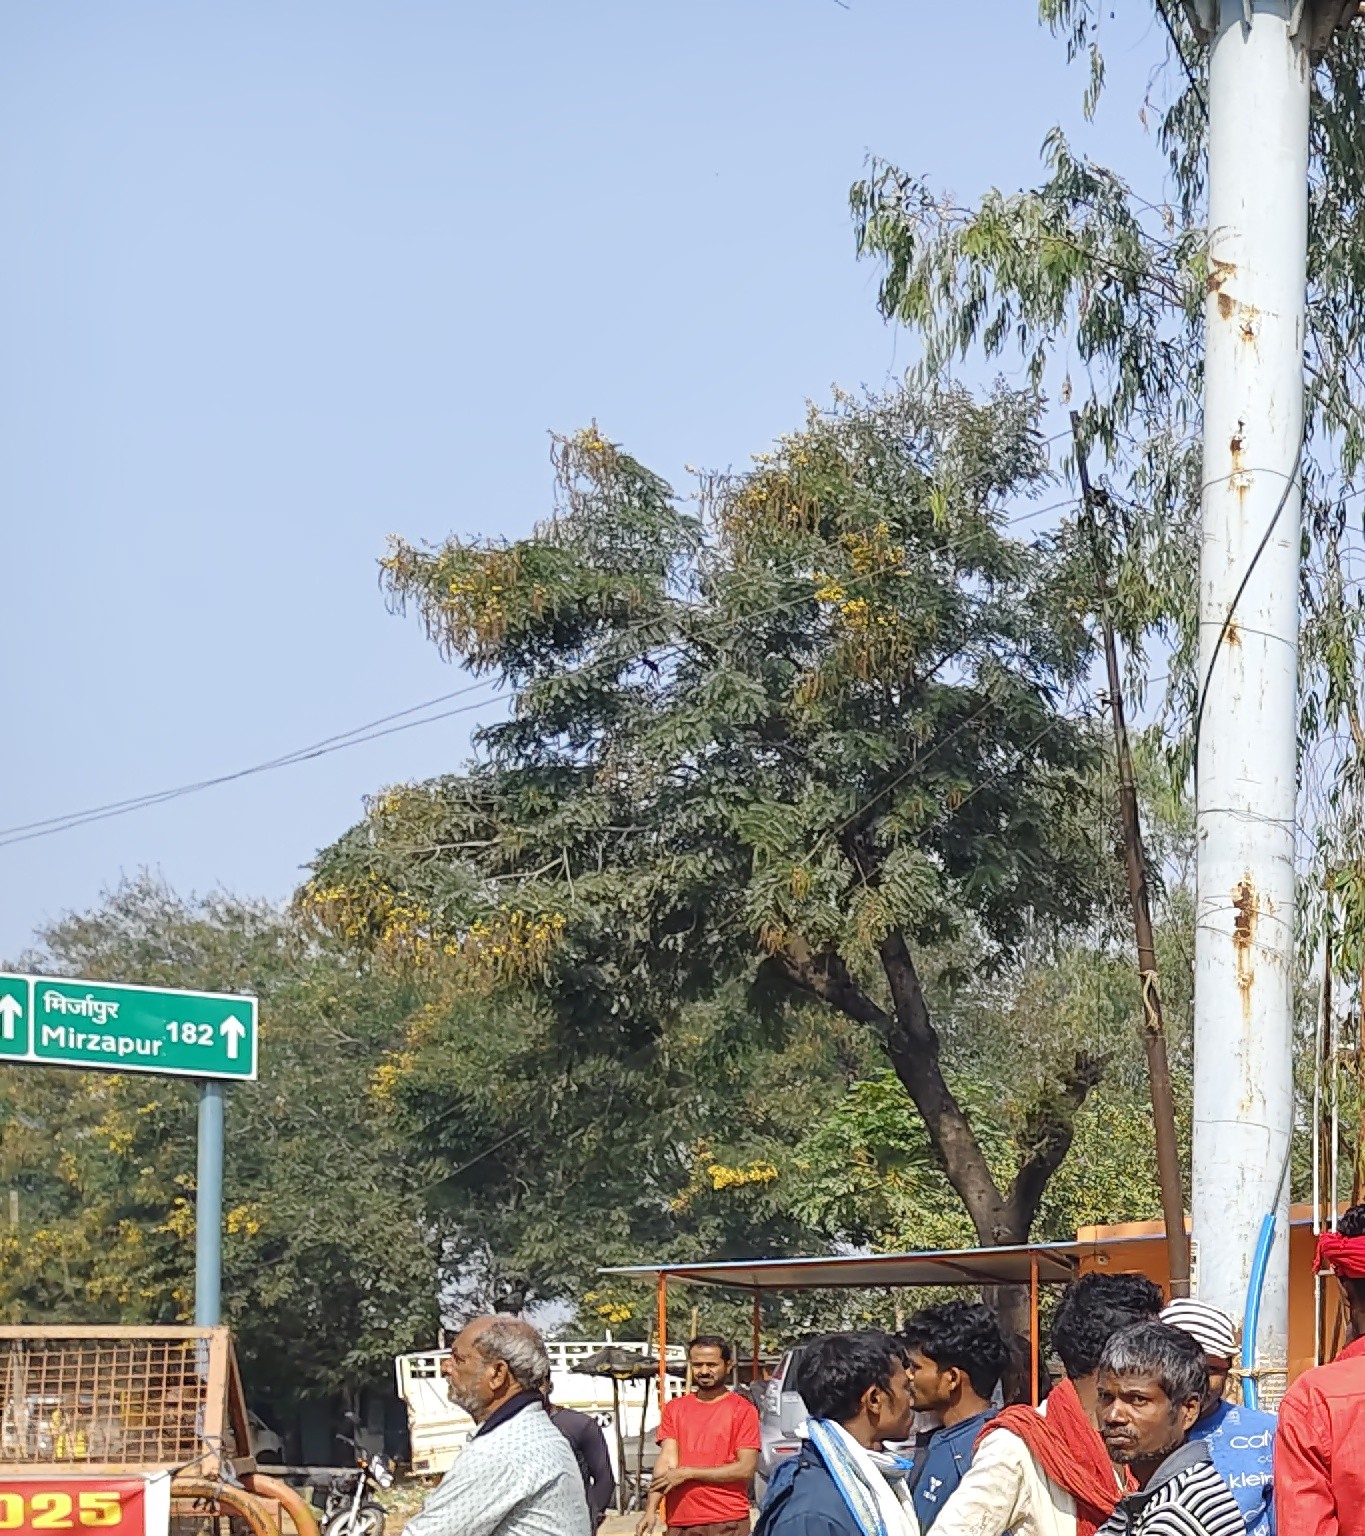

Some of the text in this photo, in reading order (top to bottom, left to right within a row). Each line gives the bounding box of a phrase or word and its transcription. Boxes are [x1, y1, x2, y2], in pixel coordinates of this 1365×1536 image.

[42, 989, 121, 1025] मिर्जापुर
[41, 1020, 215, 1056] Mirzapur 182
